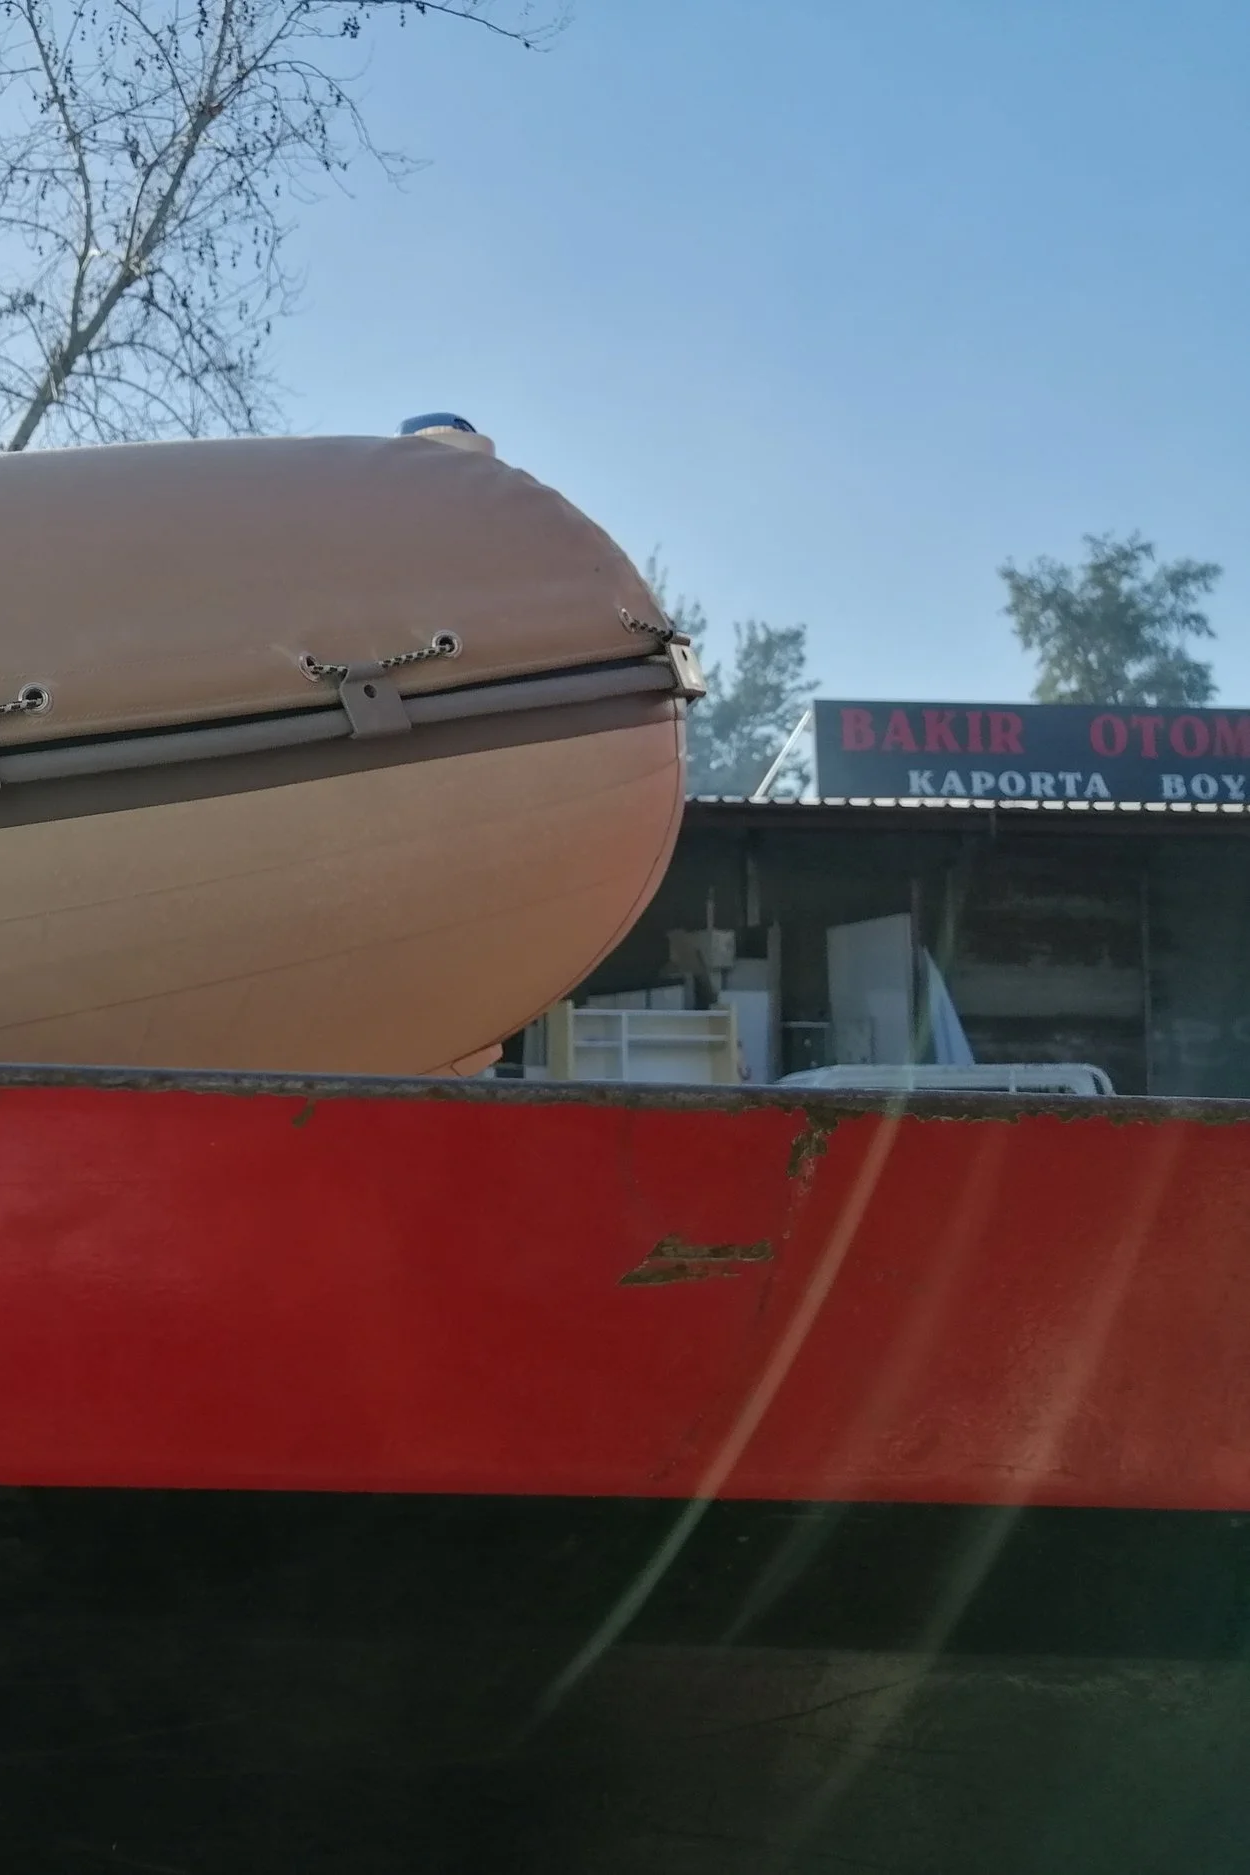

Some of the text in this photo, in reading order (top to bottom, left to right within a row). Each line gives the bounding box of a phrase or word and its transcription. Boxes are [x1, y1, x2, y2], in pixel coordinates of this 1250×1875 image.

[840, 709, 1025, 754] BAKIR
[908, 769, 1246, 800] KAPORTA BOY
